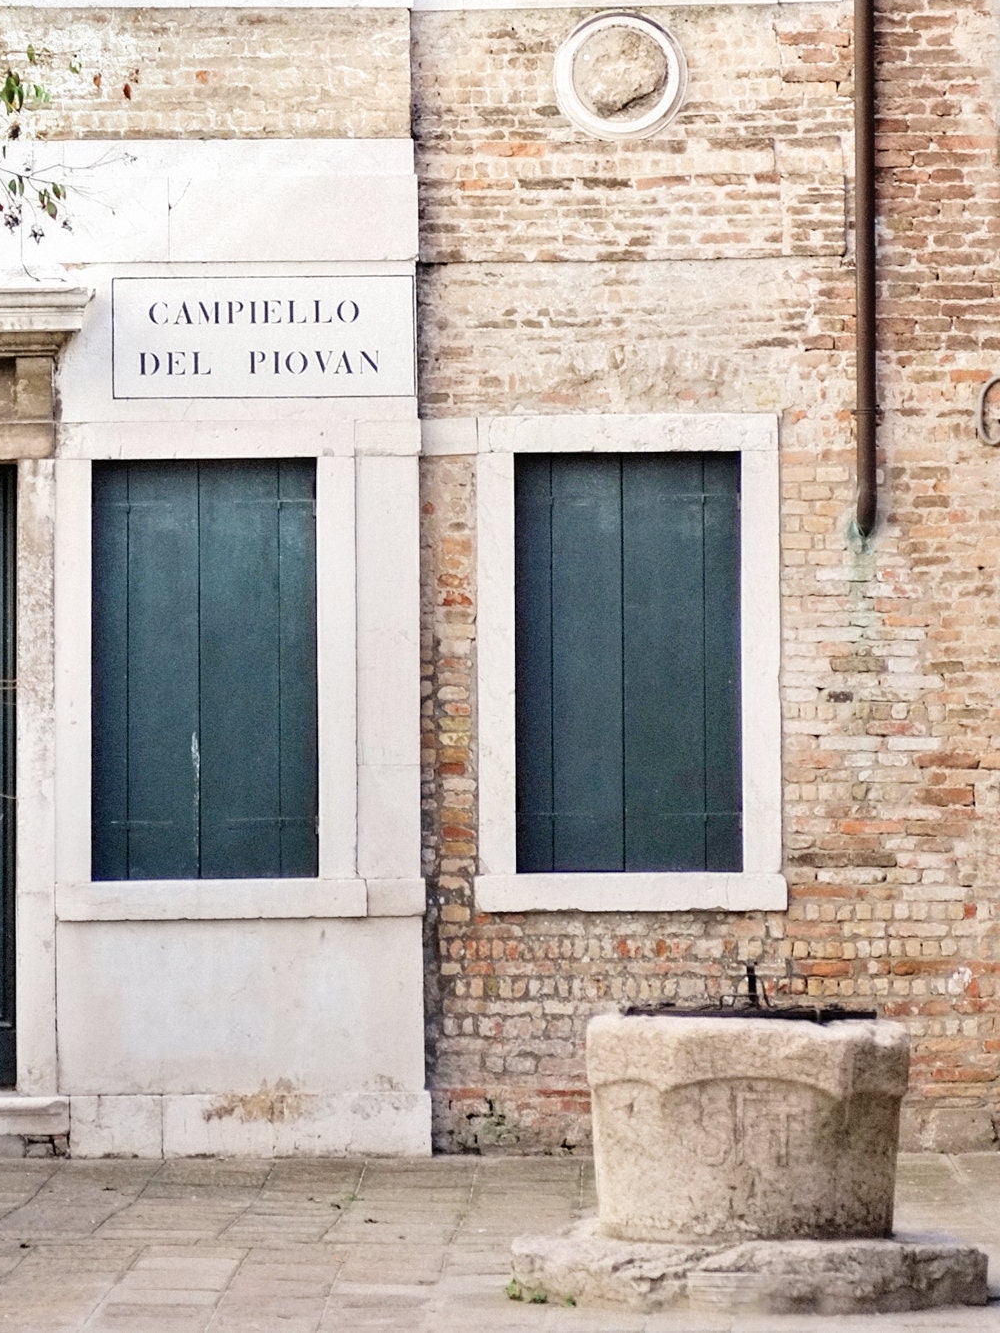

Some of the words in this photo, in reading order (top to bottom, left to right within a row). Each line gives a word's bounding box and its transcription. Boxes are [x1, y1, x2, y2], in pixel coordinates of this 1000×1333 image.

[149, 300, 360, 324] CAMPIELLO
[139, 352, 211, 375] DEL
[249, 350, 379, 375] PIOVAN
